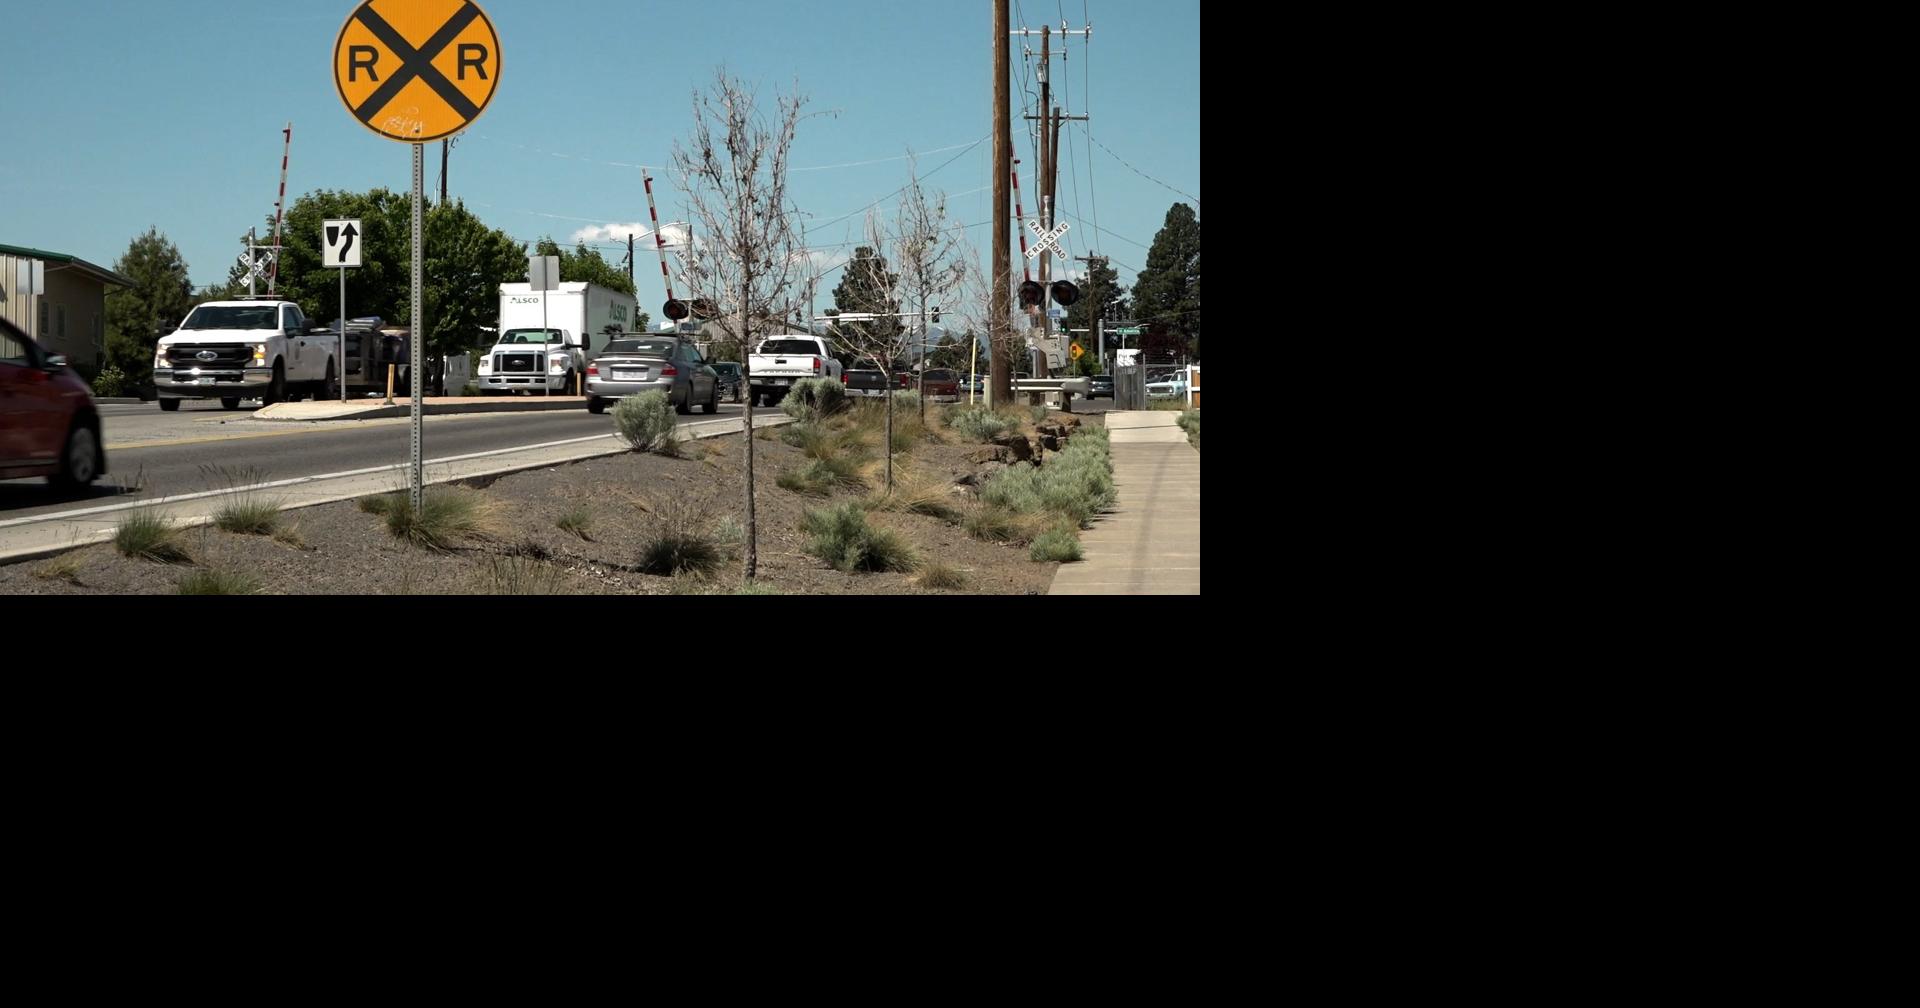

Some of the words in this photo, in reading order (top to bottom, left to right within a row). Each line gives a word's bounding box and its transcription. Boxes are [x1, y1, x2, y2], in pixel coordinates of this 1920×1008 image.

[349, 45, 379, 82] R
[457, 43, 488, 80] R
[1027, 223, 1068, 258] CROSSING
